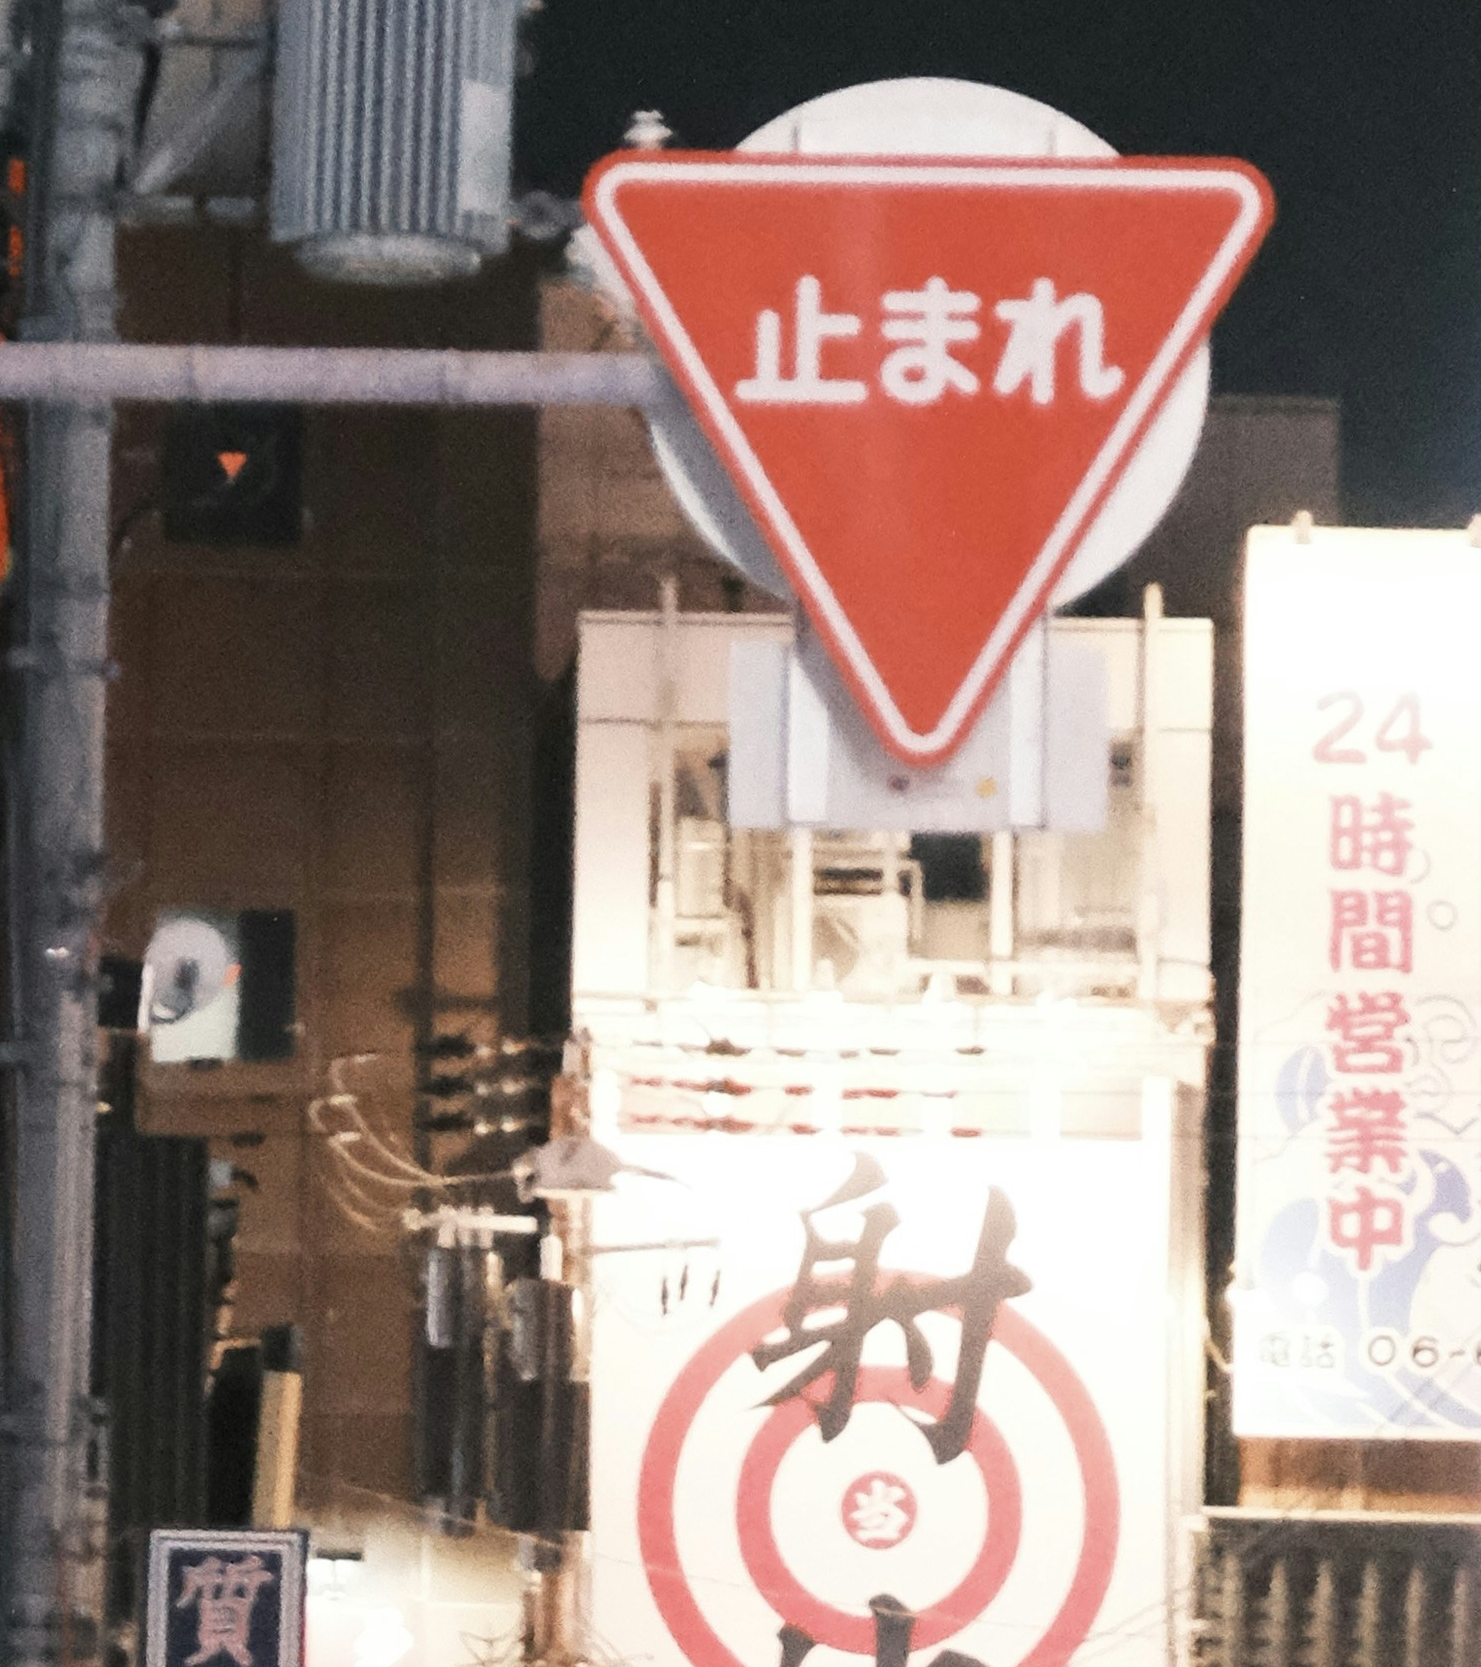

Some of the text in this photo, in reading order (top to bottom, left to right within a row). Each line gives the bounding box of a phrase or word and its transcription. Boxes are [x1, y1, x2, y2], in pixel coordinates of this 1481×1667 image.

[736, 274, 1126, 406] 止まれ
[1312, 689, 1434, 1272] 24 時間営業中
